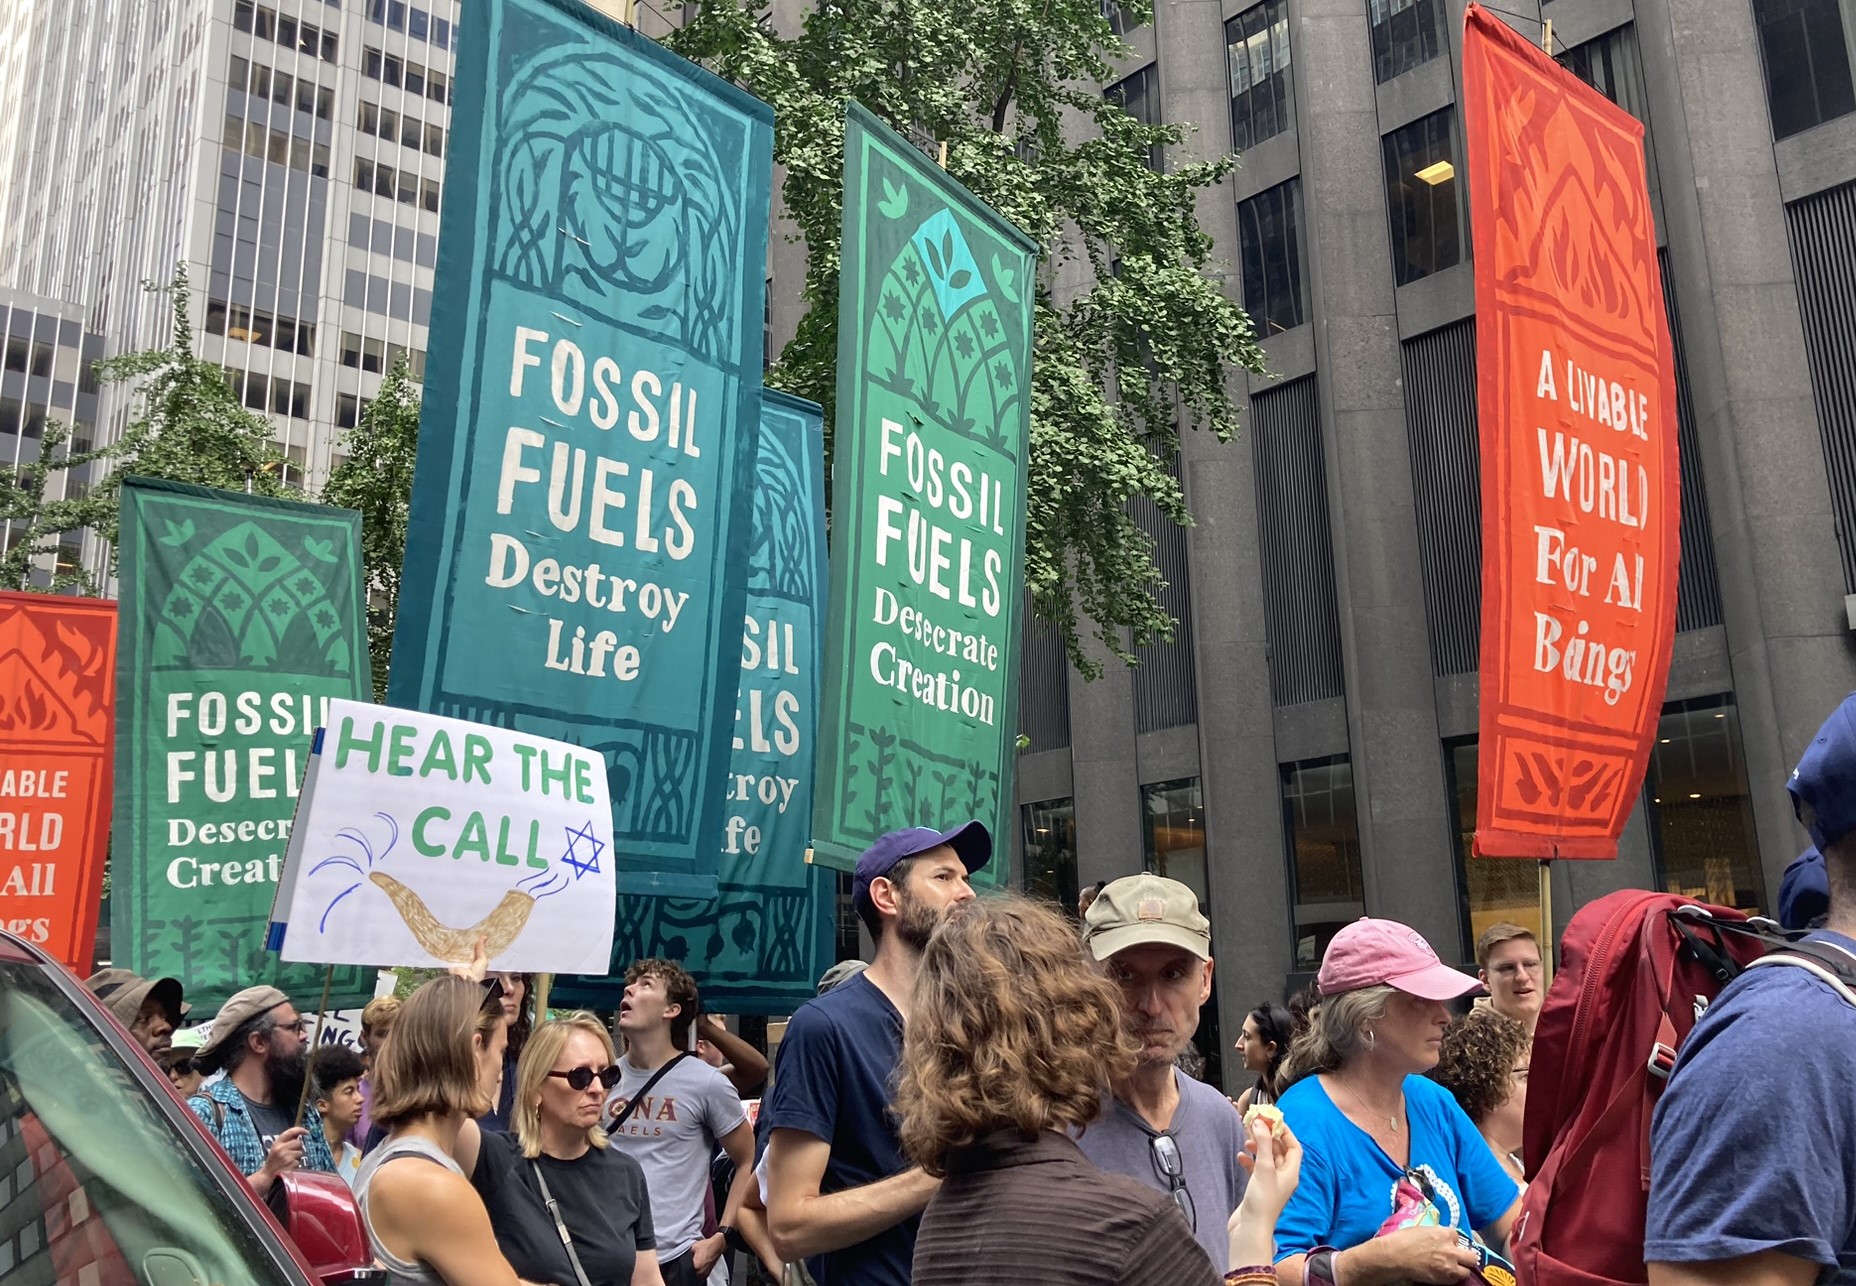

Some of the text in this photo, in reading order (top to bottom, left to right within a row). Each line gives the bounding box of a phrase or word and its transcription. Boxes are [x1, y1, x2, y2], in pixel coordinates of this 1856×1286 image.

[509, 325, 701, 458] FOSSIL
[1536, 349, 1649, 442] A LIVABLE
[496, 426, 697, 561] FUELS
[879, 416, 1004, 537] FOSSIL
[484, 532, 690, 634] Destroy
[875, 493, 1002, 618] FUELS
[1533, 524, 1597, 597] For
[544, 617, 641, 681] Life
[872, 585, 998, 672] Desecrate
[869, 640, 994, 726] Creation
[0, 769, 69, 798] ABLE
[334, 715, 595, 805] HEAR THE
[0, 862, 56, 897] All
[411, 805, 550, 870] CALL
